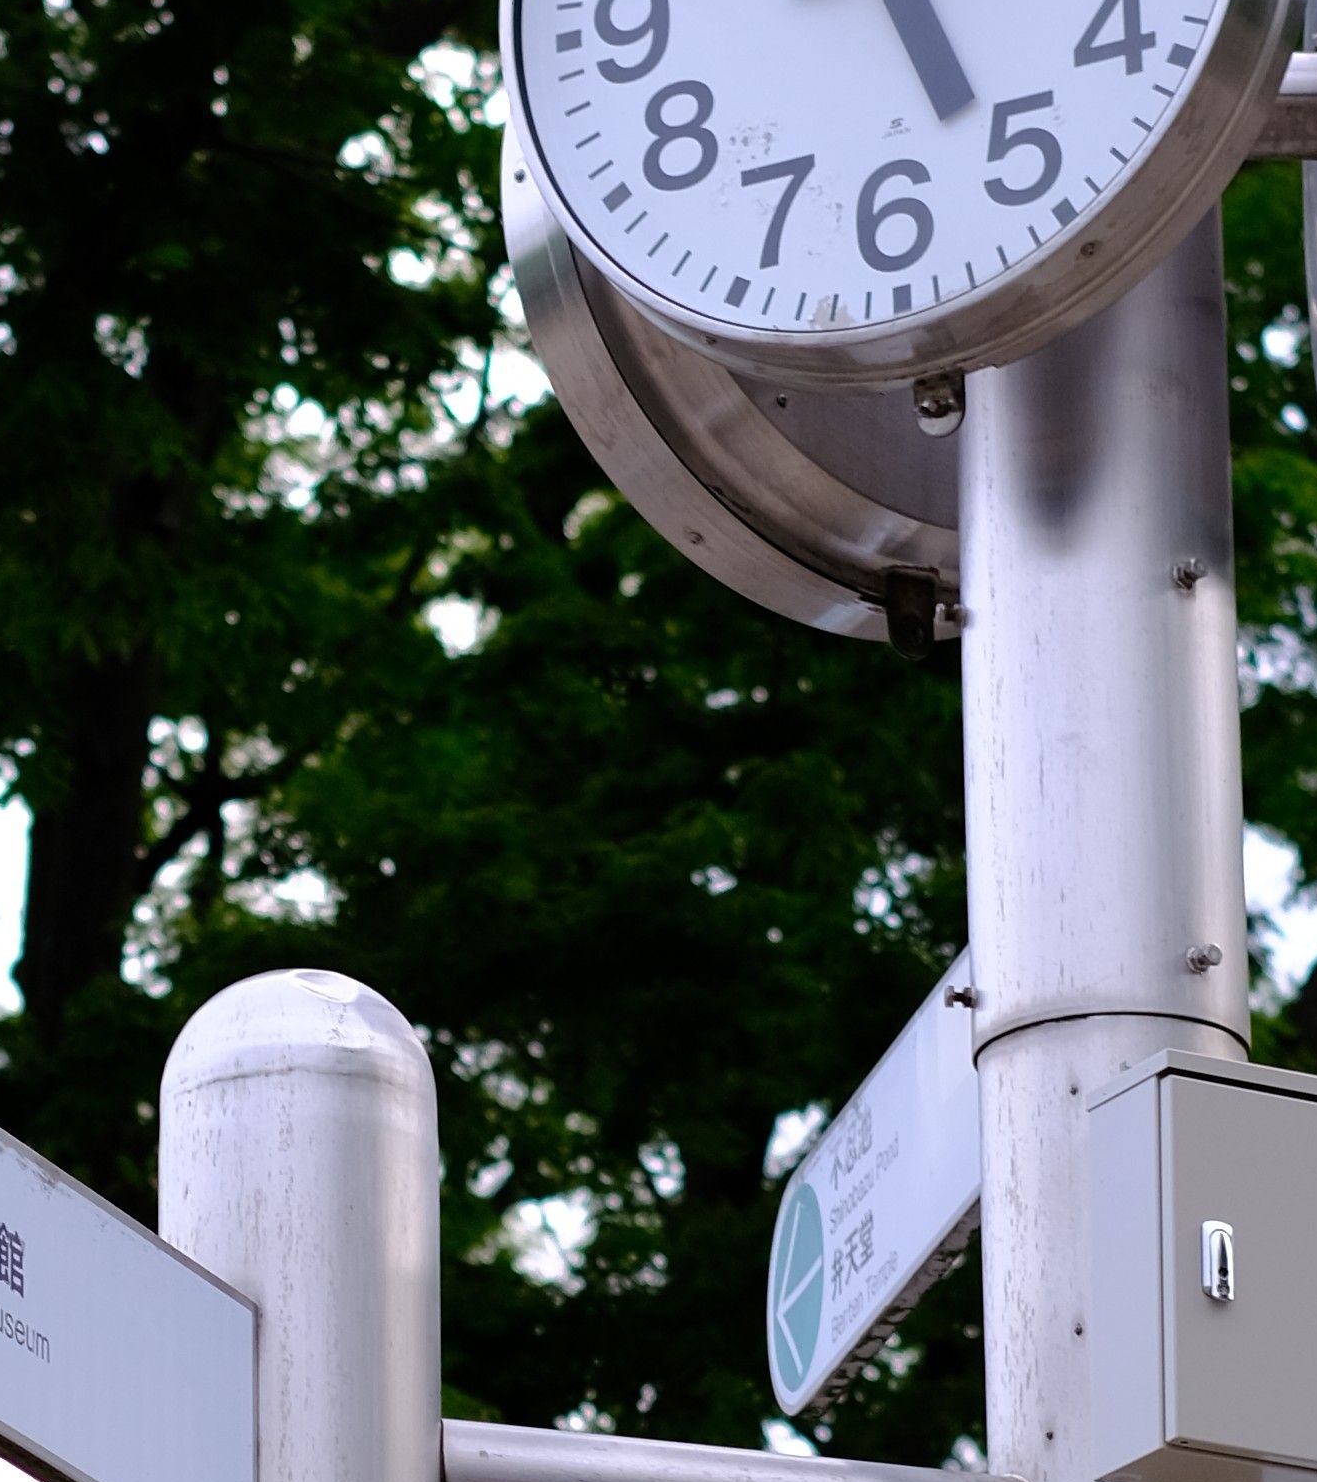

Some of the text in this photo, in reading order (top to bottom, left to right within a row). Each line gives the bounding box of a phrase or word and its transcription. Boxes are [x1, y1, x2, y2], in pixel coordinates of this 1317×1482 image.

[643, 80, 718, 191] 8
[984, 90, 1062, 206] 5
[741, 154, 815, 269] 7
[857, 159, 935, 272] 6
[831, 1212, 874, 1301] 弁天堂
